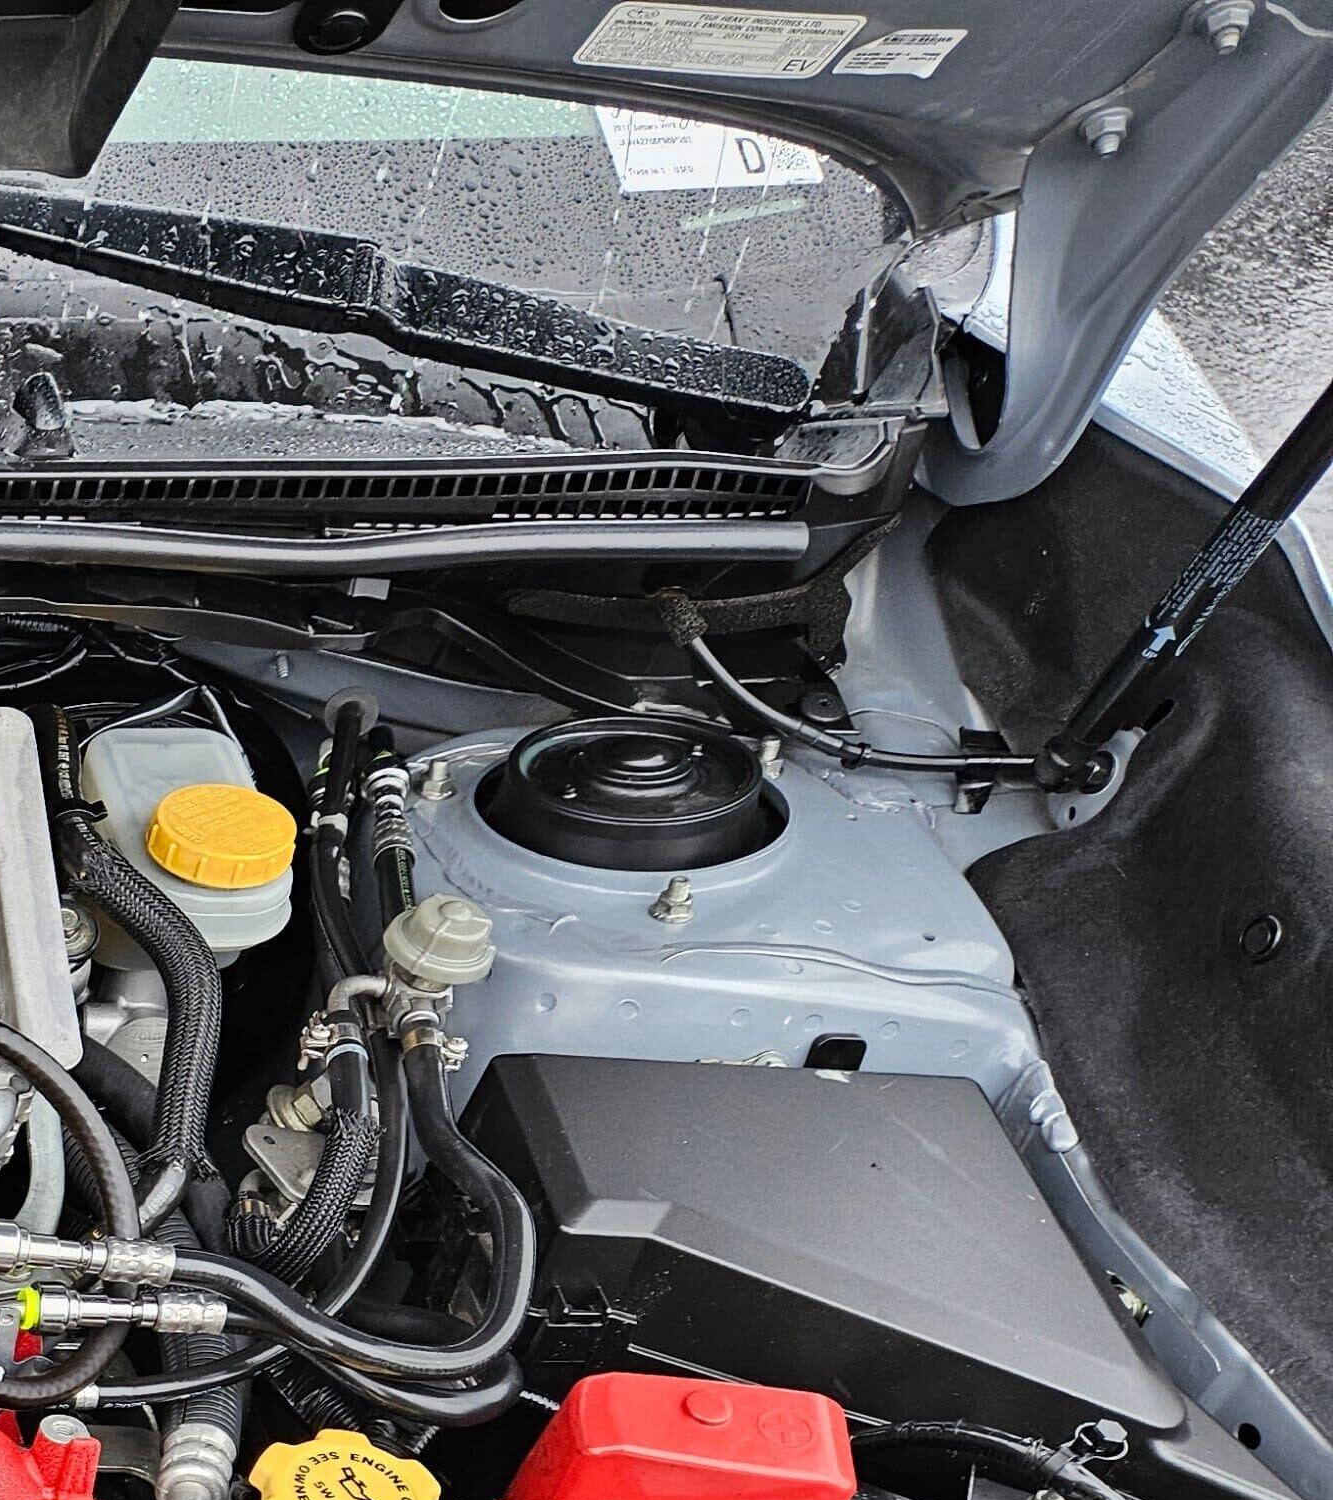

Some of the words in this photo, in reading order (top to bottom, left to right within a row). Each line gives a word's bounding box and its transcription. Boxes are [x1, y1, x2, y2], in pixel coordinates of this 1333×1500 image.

[614, 19, 659, 27] SUBARU
[664, 20, 698, 29] VEHICLE
[701, 21, 743, 32] EMISSION
[746, 24, 784, 34] CONTROL
[786, 27, 846, 36] INFORMATION
[700, 14, 719, 22] FUJI
[721, 15, 750, 24] HEAVY
[753, 17, 803, 27] INDUSTRIES
[782, 59, 818, 72] EV
[735, 137, 766, 174] D
[310, 1451, 340, 1466] SEE
[350, 1453, 408, 1493] ENGINE
